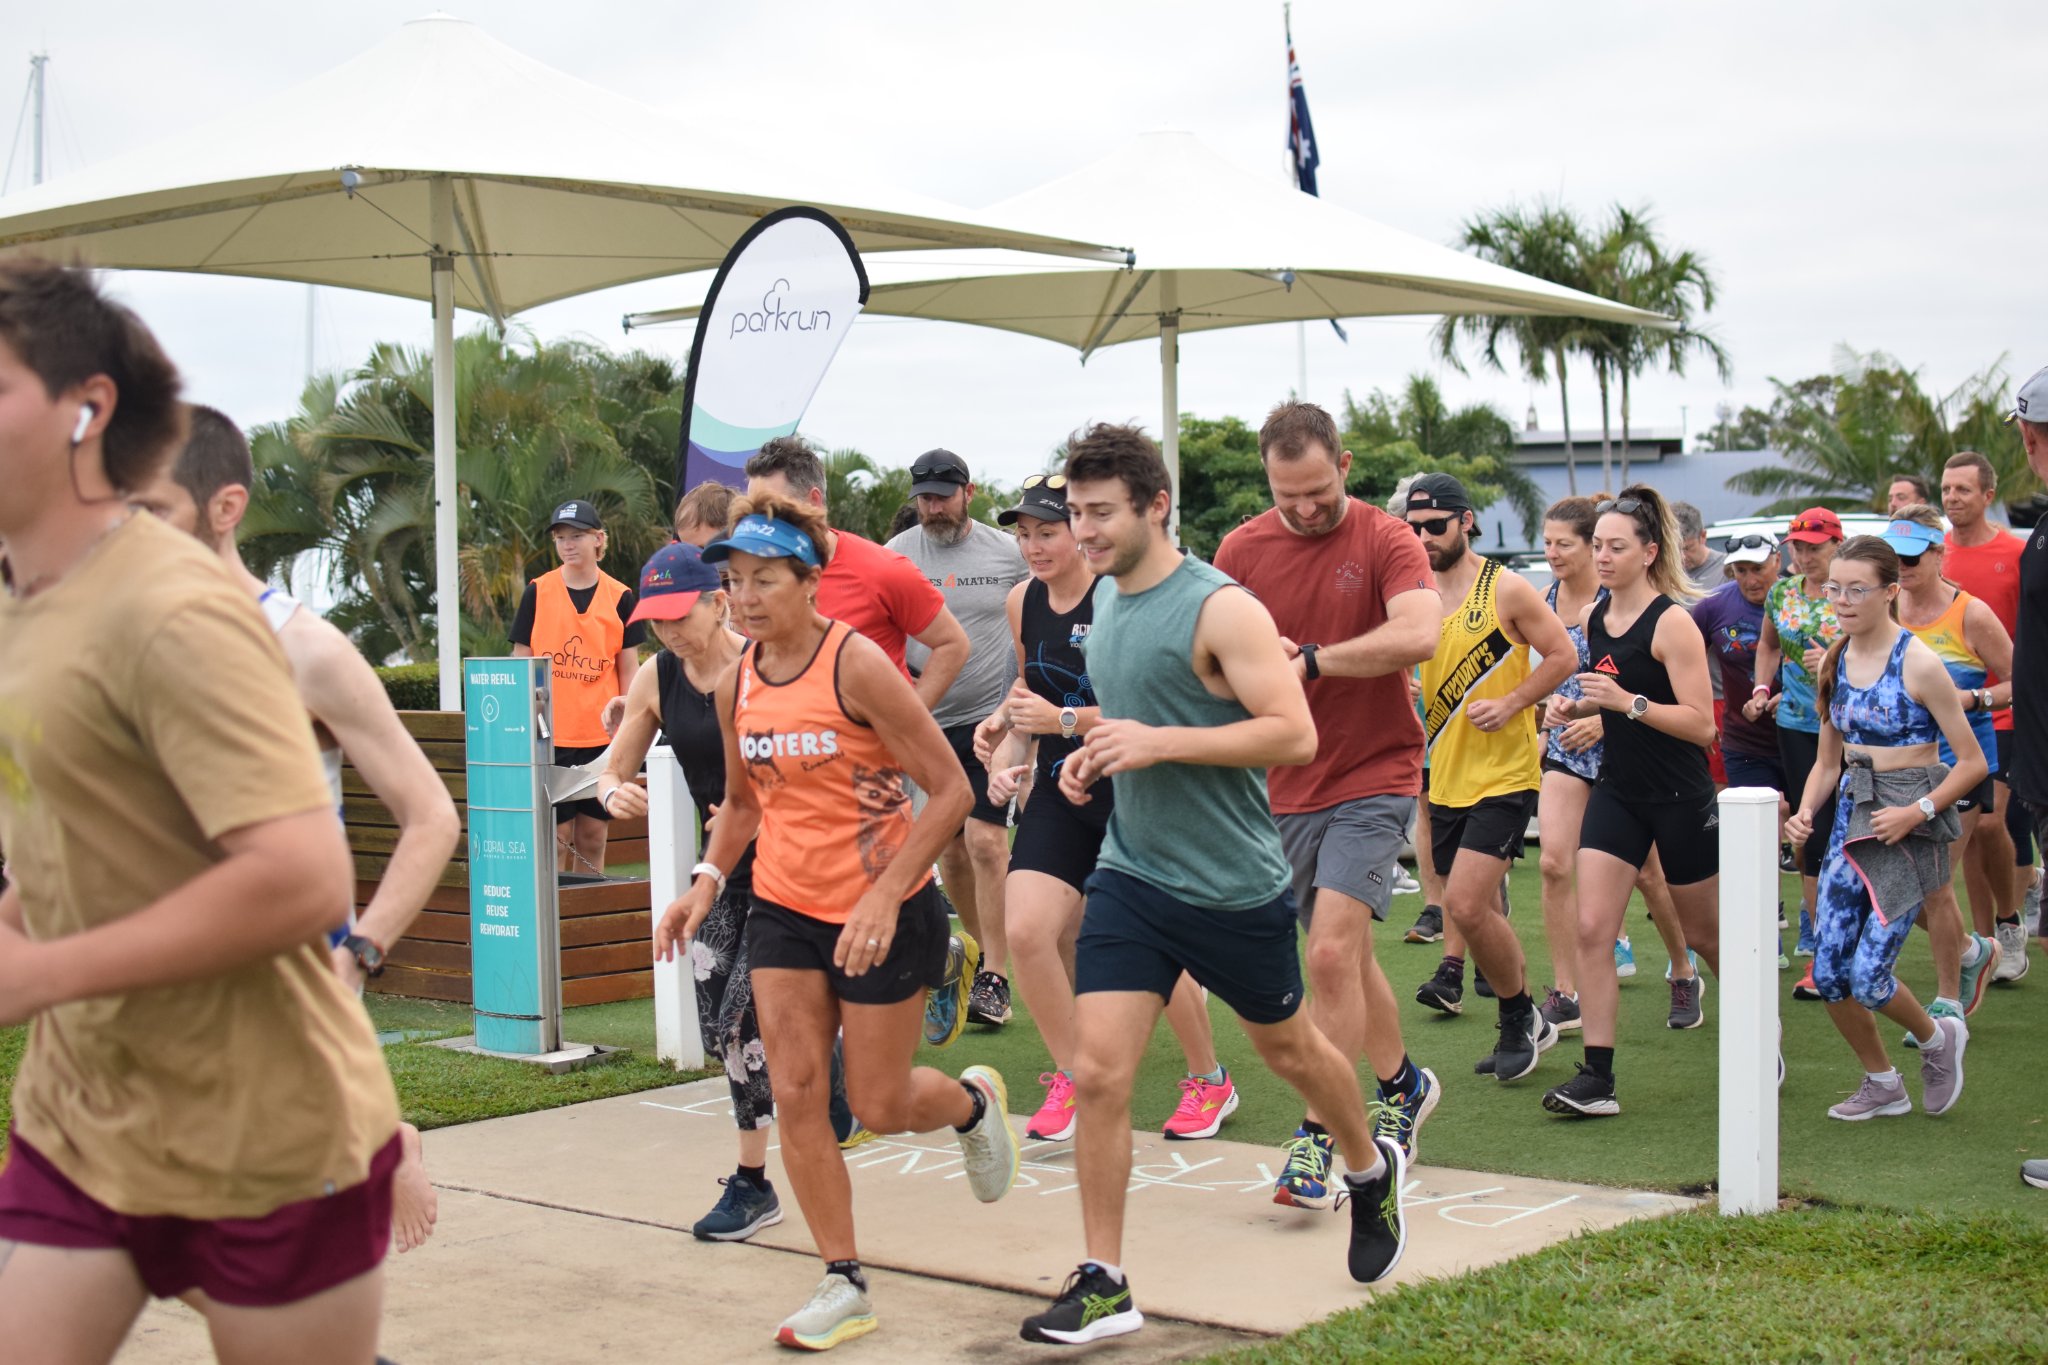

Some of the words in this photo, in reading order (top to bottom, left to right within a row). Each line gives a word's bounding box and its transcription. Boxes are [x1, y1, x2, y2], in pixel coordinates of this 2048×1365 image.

[730, 278, 831, 340] parkrun
[1040, 498, 1064, 510] 2XU
[944, 573, 956, 590] 4
[957, 576, 999, 586] MATES
[541, 635, 611, 672] arkrun
[470, 673, 489, 685] WATER
[490, 673, 517, 685] REFILL
[483, 840, 505, 853] CORAL
[508, 841, 527, 854] SEA
[483, 884, 511, 898] REDUCE
[486, 904, 509, 918] REUSE
[480, 922, 520, 938] REHYDRATE
